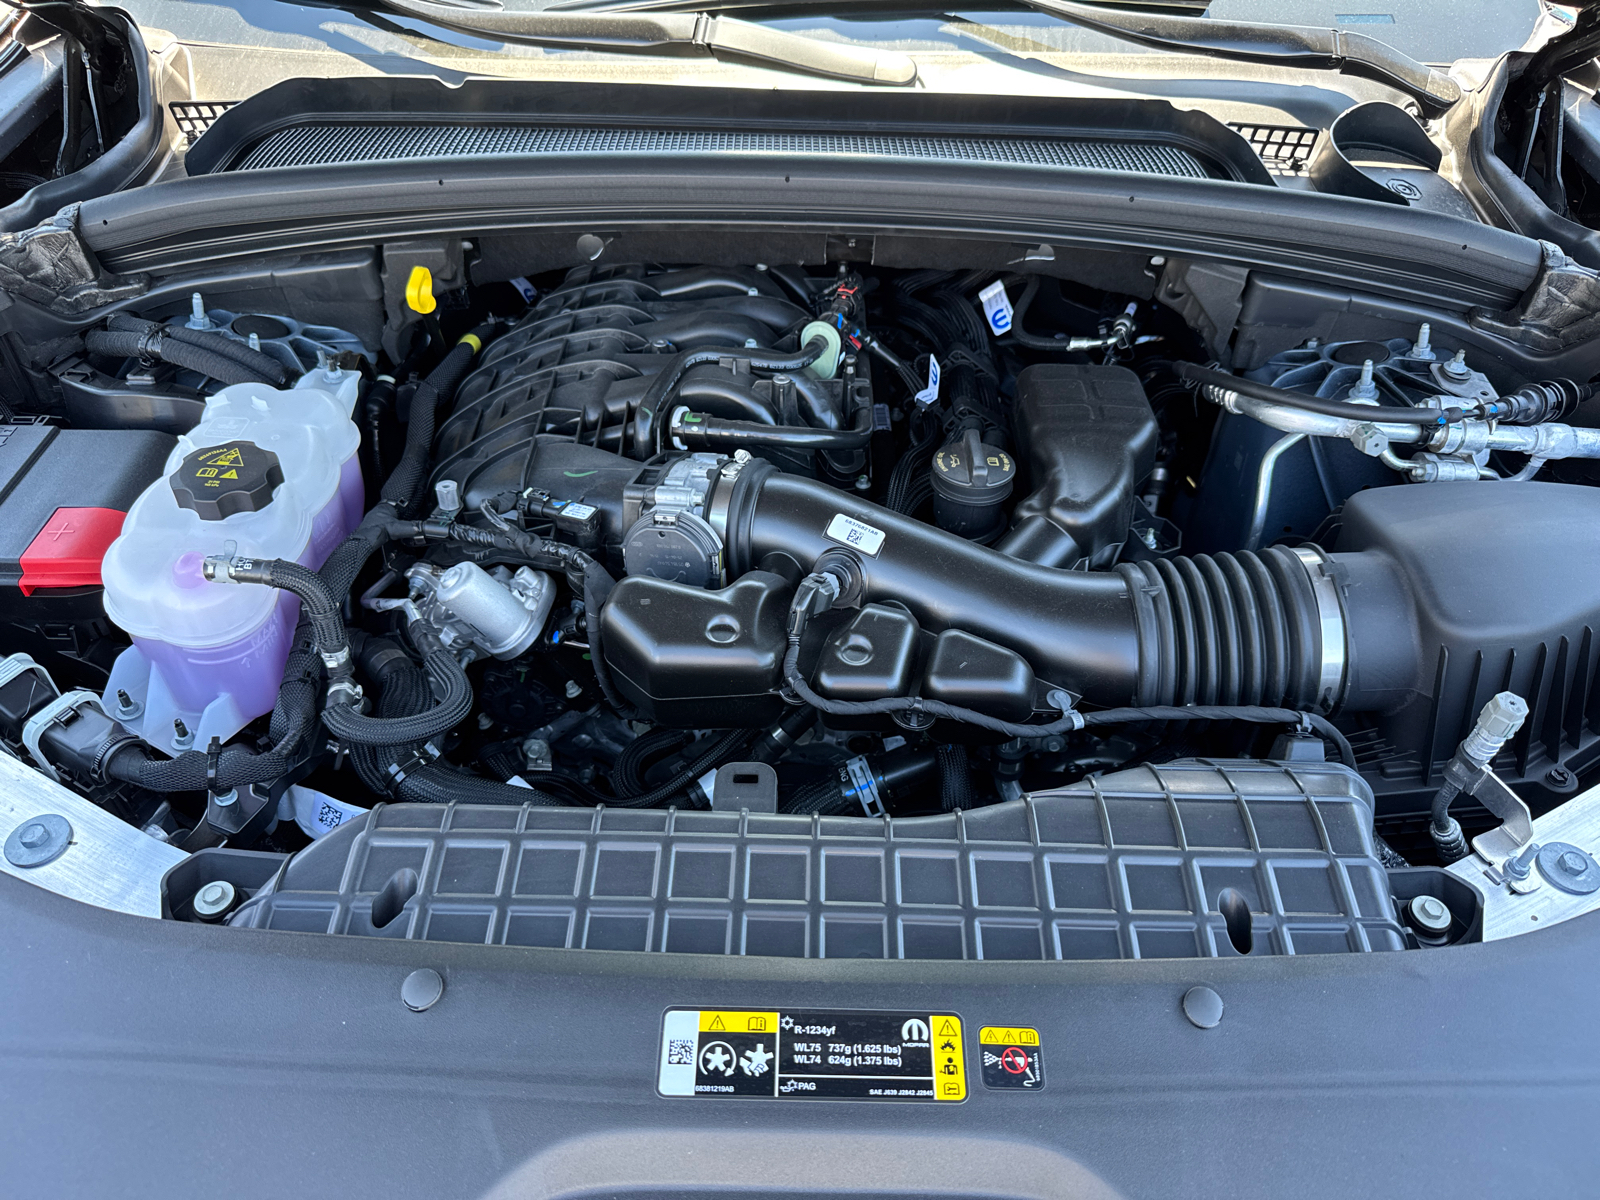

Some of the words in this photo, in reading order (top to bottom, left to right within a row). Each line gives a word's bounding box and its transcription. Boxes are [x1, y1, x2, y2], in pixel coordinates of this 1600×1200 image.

[794, 1025, 837, 1037] R-1234yf
[793, 1043, 821, 1053] WL75
[827, 1043, 852, 1055] 737g
[853, 1044, 882, 1054] (1.625
[883, 1045, 902, 1056] lbs)
[793, 1055, 821, 1064] WL74
[827, 1055, 852, 1066] 624g
[853, 1055, 882, 1066] (1.375
[883, 1056, 903, 1068] lbs)
[798, 1082, 817, 1091] PAG
